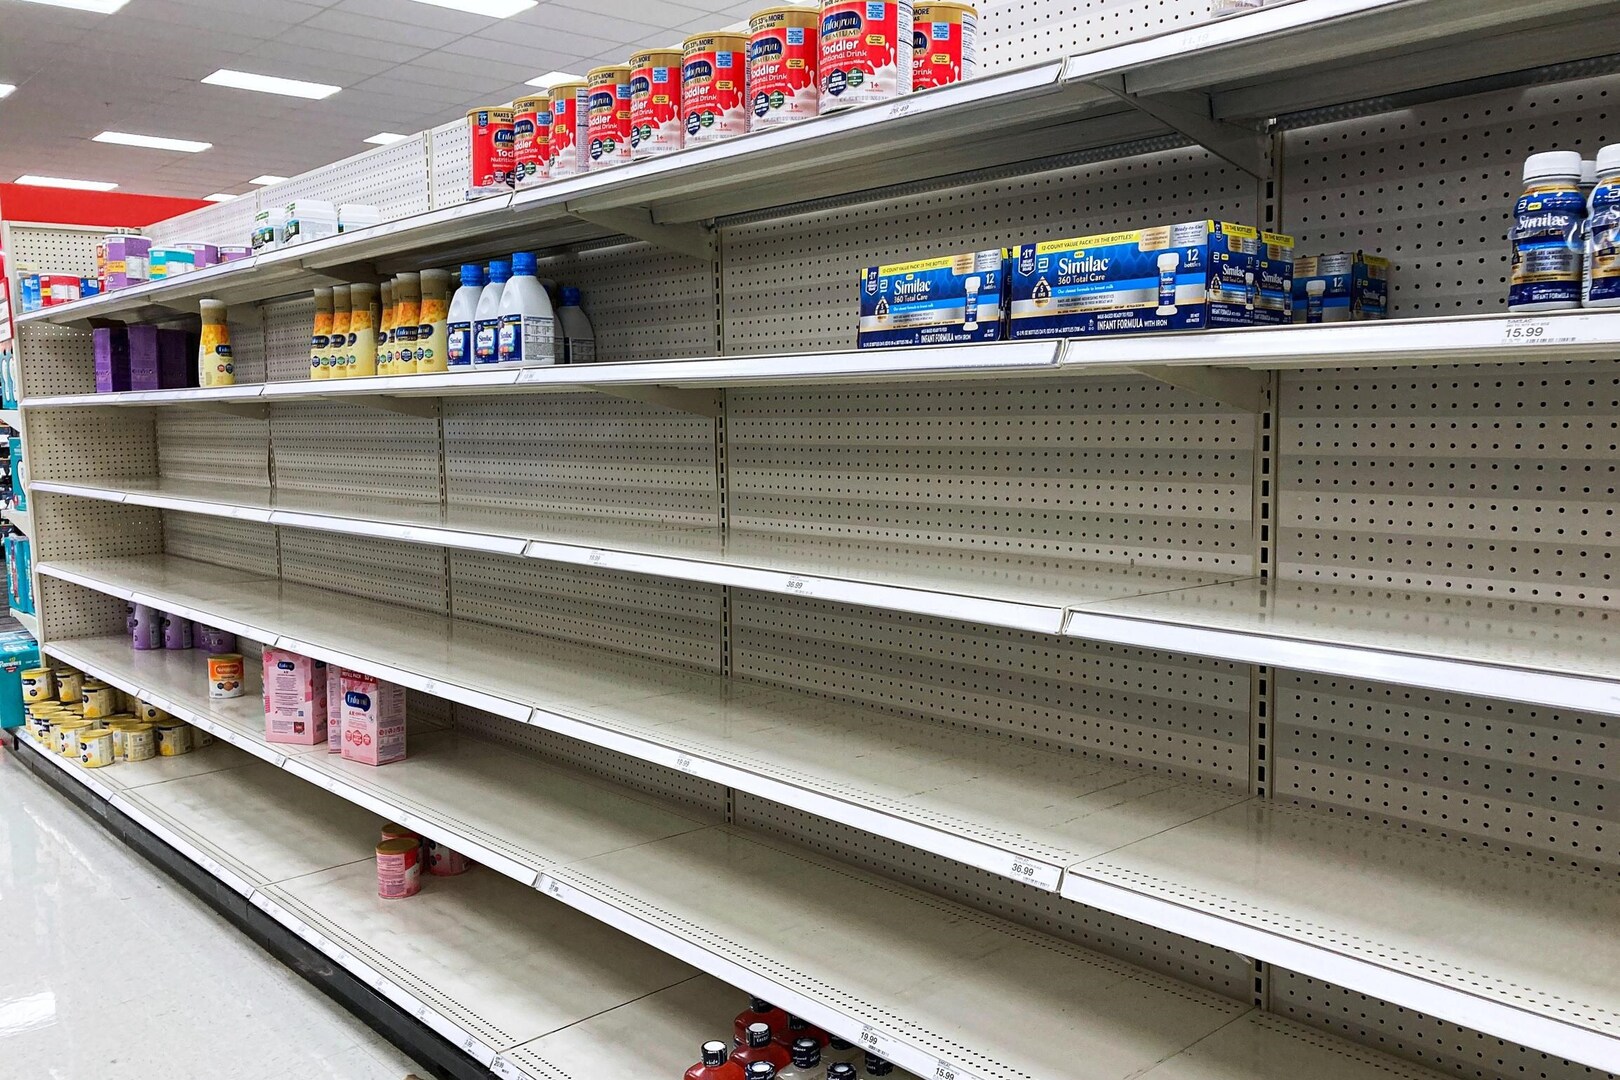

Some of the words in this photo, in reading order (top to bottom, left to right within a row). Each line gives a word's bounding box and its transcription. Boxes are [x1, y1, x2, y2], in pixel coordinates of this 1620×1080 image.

[768, 14, 784, 22] MORE
[699, 38, 714, 46] MORE
[822, 40, 859, 55] Toddler
[1517, 212, 1569, 230] Similac
[1187, 249, 1199, 262] 12
[1058, 256, 1108, 276] Similac
[1222, 264, 1245, 278] Similac
[986, 273, 995, 284] 12
[1058, 276, 1070, 285] 360
[1072, 274, 1088, 283] Total
[1090, 273, 1105, 282] Care
[1262, 271, 1283, 284] Similac
[1333, 277, 1344, 288] 12
[894, 278, 932, 296] Similac
[1097, 320, 1116, 330] INFANT
[1117, 318, 1144, 330] FORMULA
[1505, 326, 1544, 338] 15.99
[1012, 864, 1034, 876] 36.99
[860, 1032, 878, 1044] 19.99
[936, 1067, 955, 1080] 15.99
